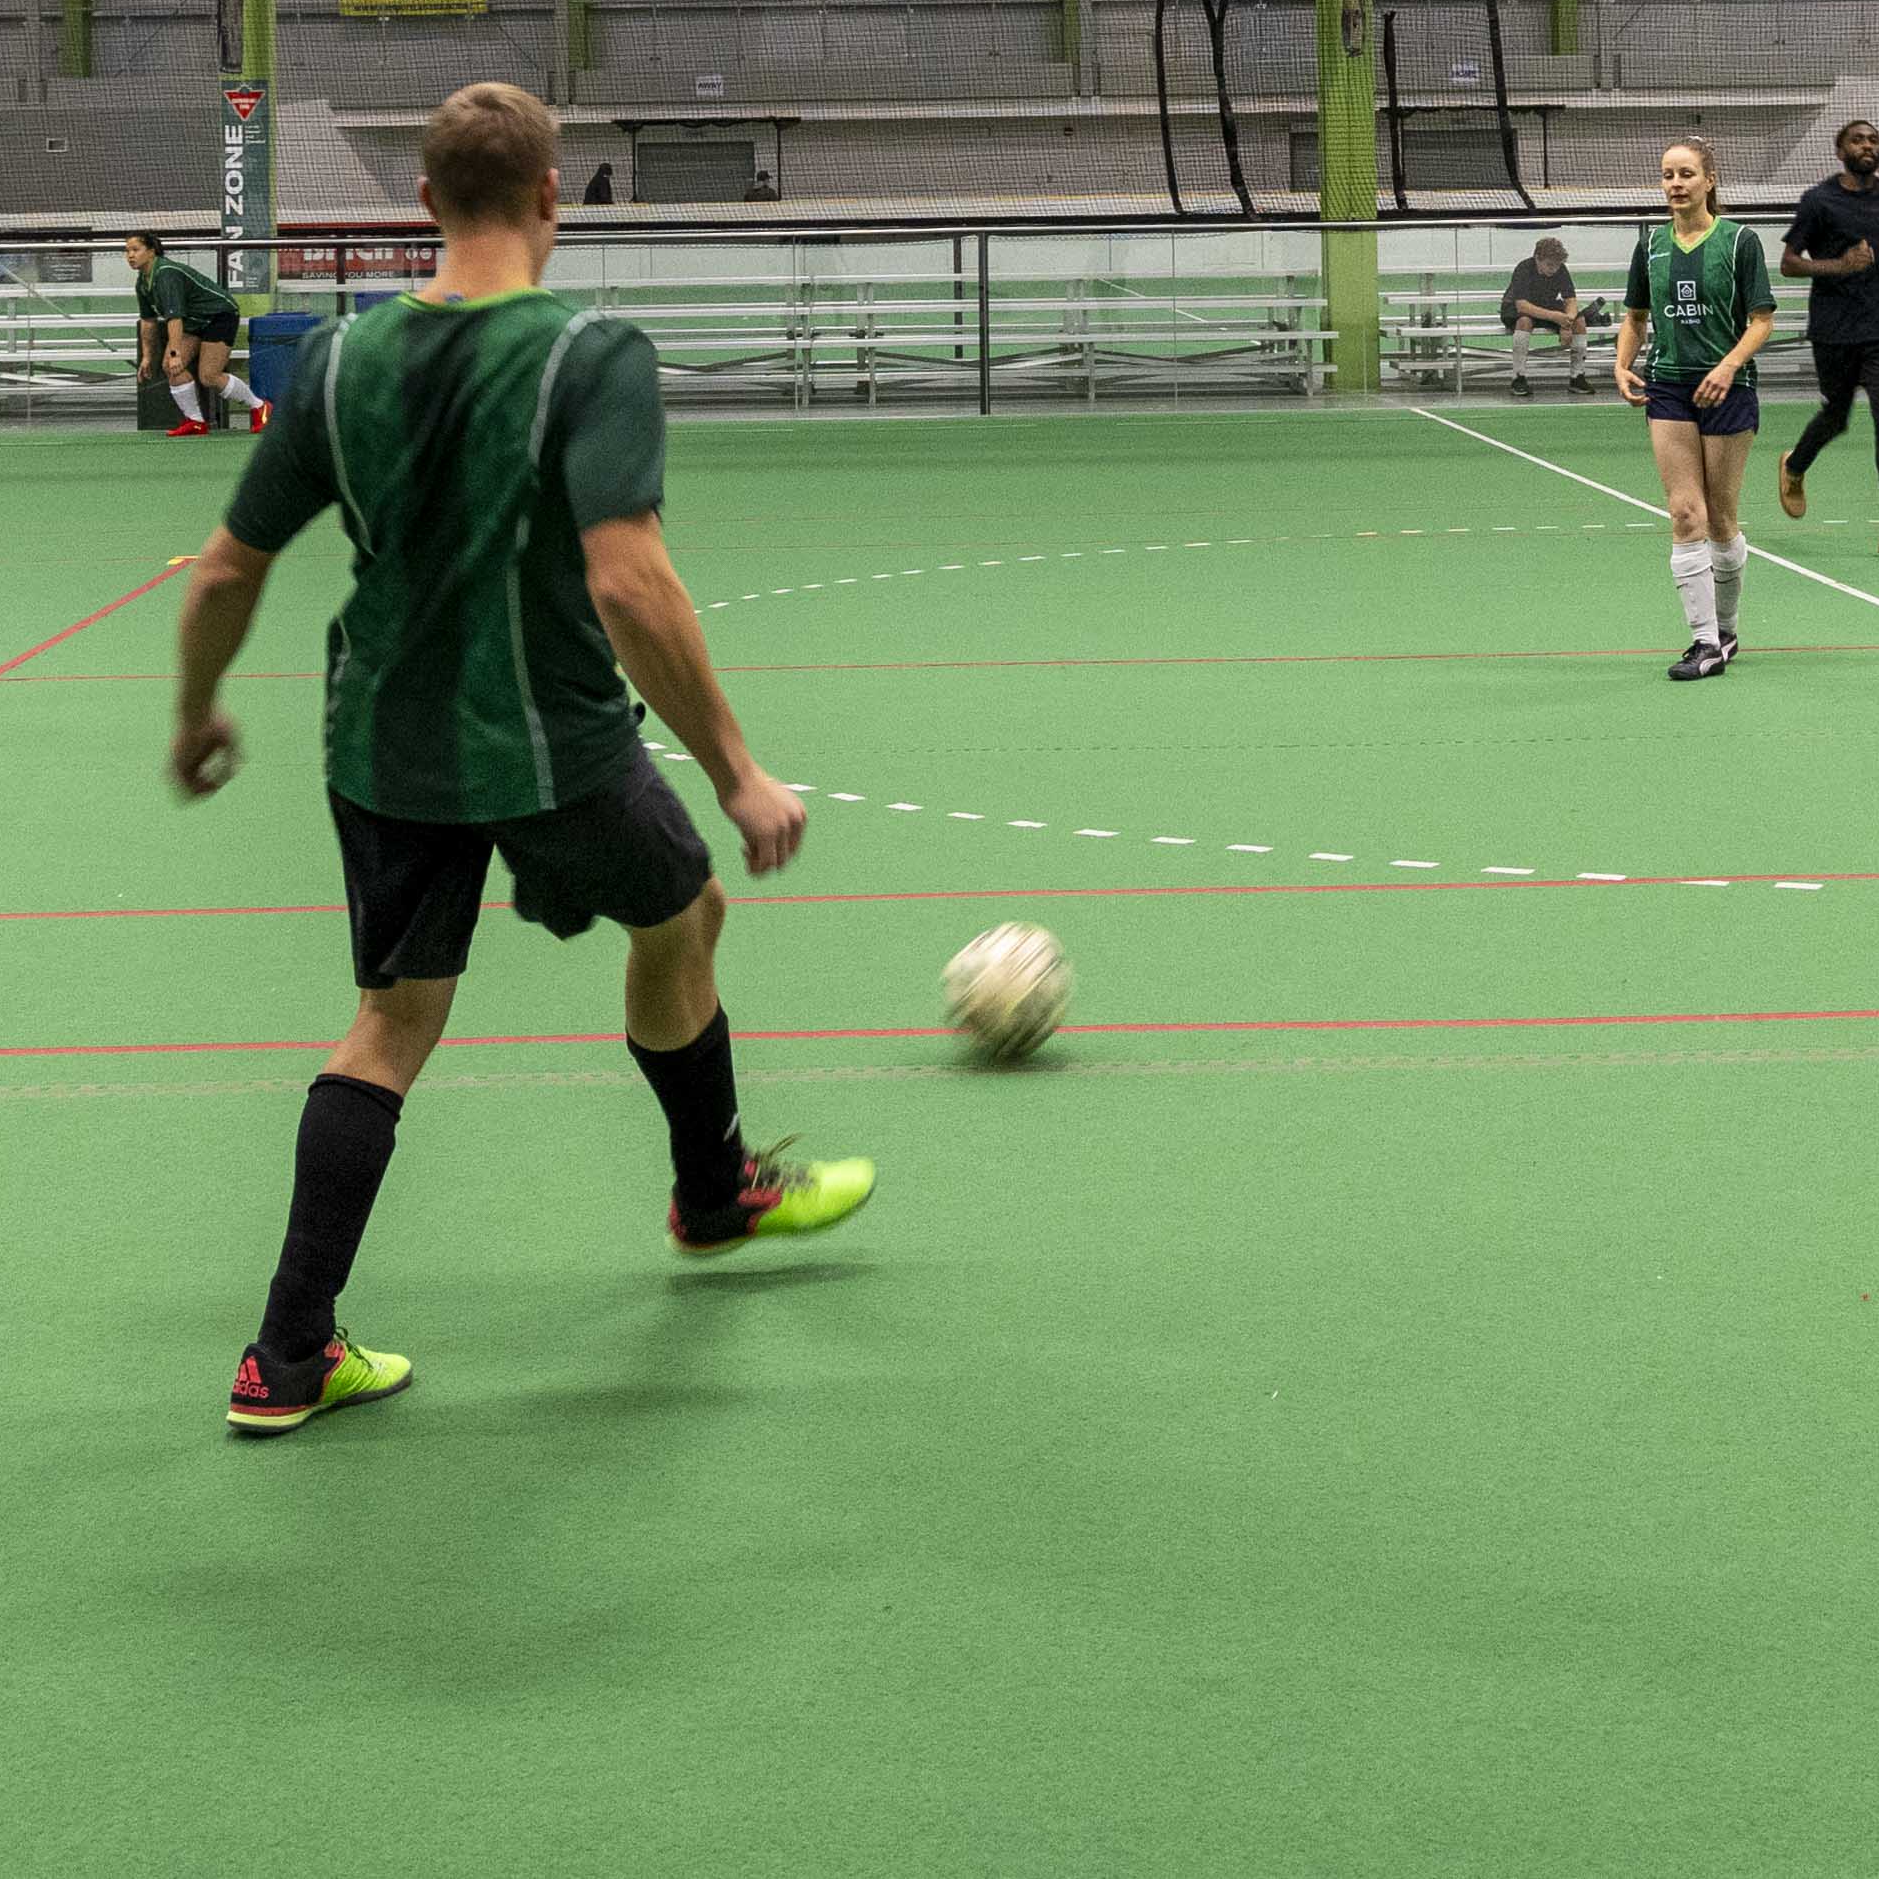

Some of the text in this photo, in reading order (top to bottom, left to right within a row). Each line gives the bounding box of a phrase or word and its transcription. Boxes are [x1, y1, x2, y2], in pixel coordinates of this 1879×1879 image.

[225, 124, 244, 216] ZONE
[346, 271, 363, 279] OU
[365, 271, 394, 279] MORE
[1664, 303, 1714, 318] CABIN
